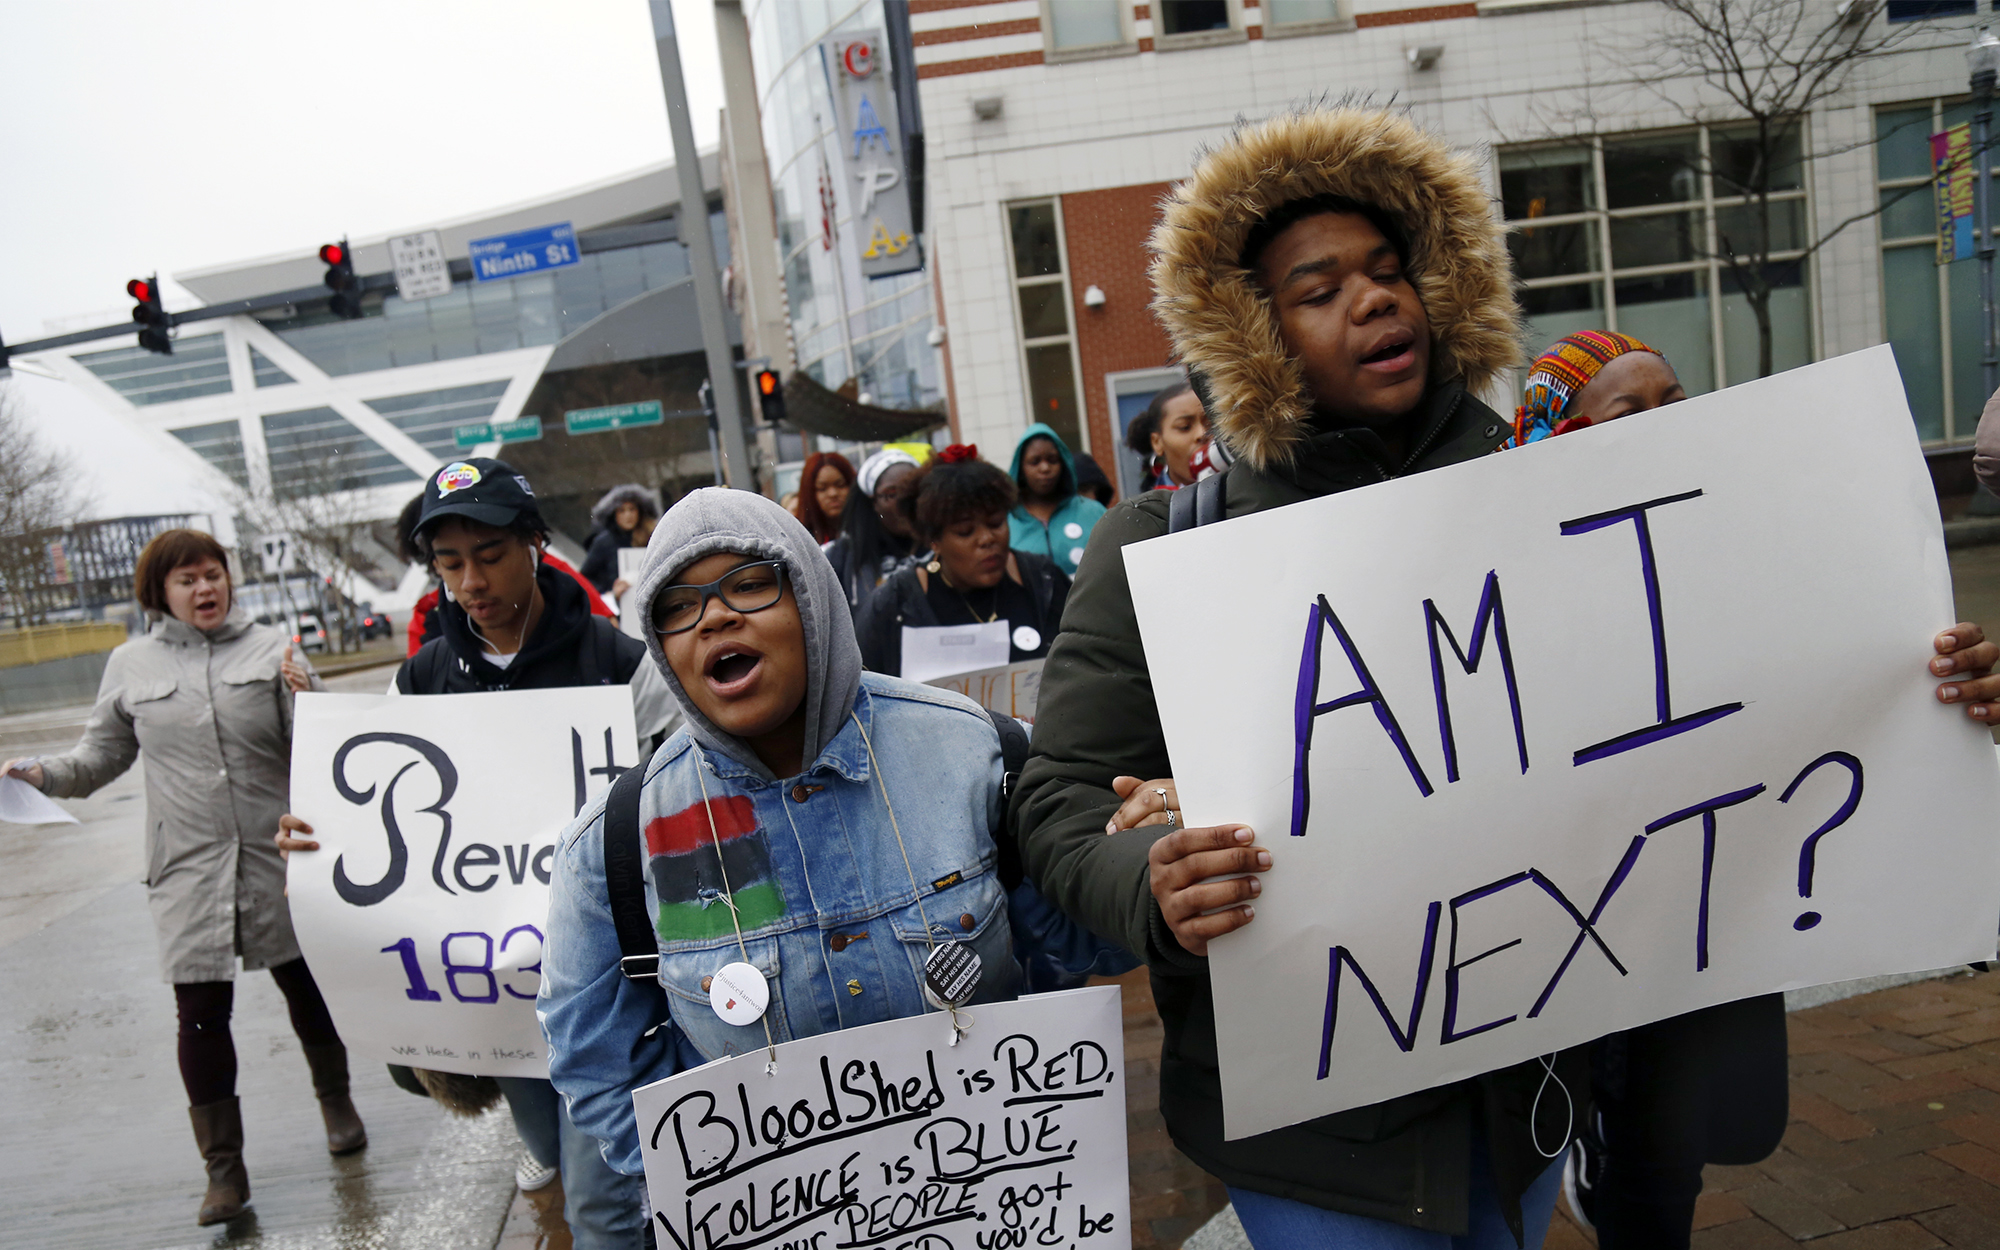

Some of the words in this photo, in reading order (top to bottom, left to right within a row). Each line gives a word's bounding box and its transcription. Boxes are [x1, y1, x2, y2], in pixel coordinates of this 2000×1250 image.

[398, 248, 437, 263] TURN
[402, 235, 424, 247] NO
[480, 249, 537, 278] Ninth
[545, 243, 571, 265] St
[1291, 568, 1529, 836] AM
[1560, 488, 1745, 766] I
[609, 819, 632, 892] Calvin
[616, 896, 643, 944] Klein
[1317, 751, 1865, 1080] NEXT?
[926, 962, 937, 974] SAY
[936, 952, 945, 964] HIS
[932, 969, 943, 981] SAY
[941, 960, 951, 971] HIS
[949, 944, 964, 962] NAME
[939, 975, 950, 988] SAY
[948, 966, 958, 978] HIS
[956, 951, 971, 969] NAME
[947, 985, 958, 997] SAY
[957, 975, 966, 987] HIS
[964, 961, 978, 978] NAME
[965, 984, 974, 995] HIS
[392, 1045, 420, 1057] We
[467, 1050, 481, 1060] in
[490, 1047, 538, 1060] these
[652, 1050, 945, 1180] BloodShed
[957, 1069, 994, 1095] is
[994, 1034, 1115, 1093] RED,
[880, 1155, 915, 1186] is
[914, 1105, 1077, 1178] BLUE,
[998, 1171, 1073, 1228] got
[1079, 1204, 1114, 1238] be
